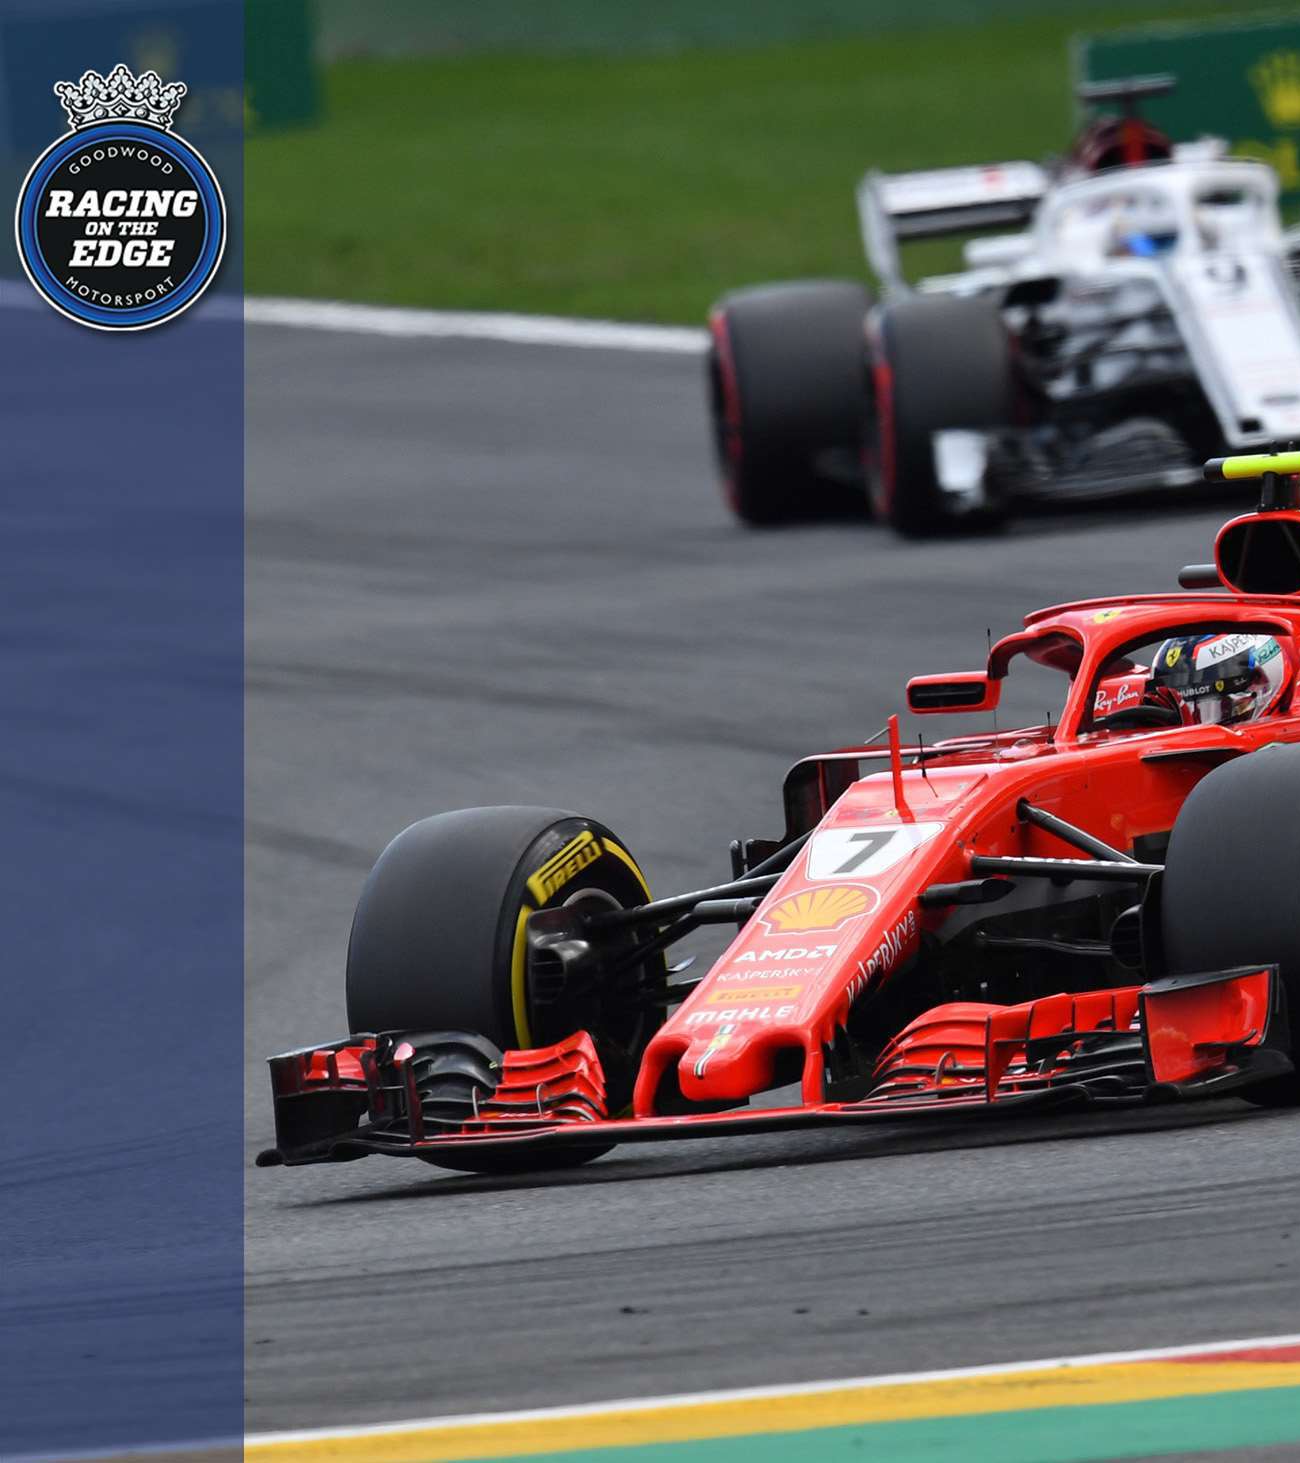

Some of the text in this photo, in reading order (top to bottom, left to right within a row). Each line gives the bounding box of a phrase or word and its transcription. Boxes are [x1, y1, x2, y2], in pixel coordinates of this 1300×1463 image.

[832, 830, 898, 875] 7
[526, 830, 603, 907] PIRELLI
[733, 948, 810, 964] AMD
[717, 967, 812, 983] KASPERSKY
[684, 1004, 796, 1025] MAHLE
